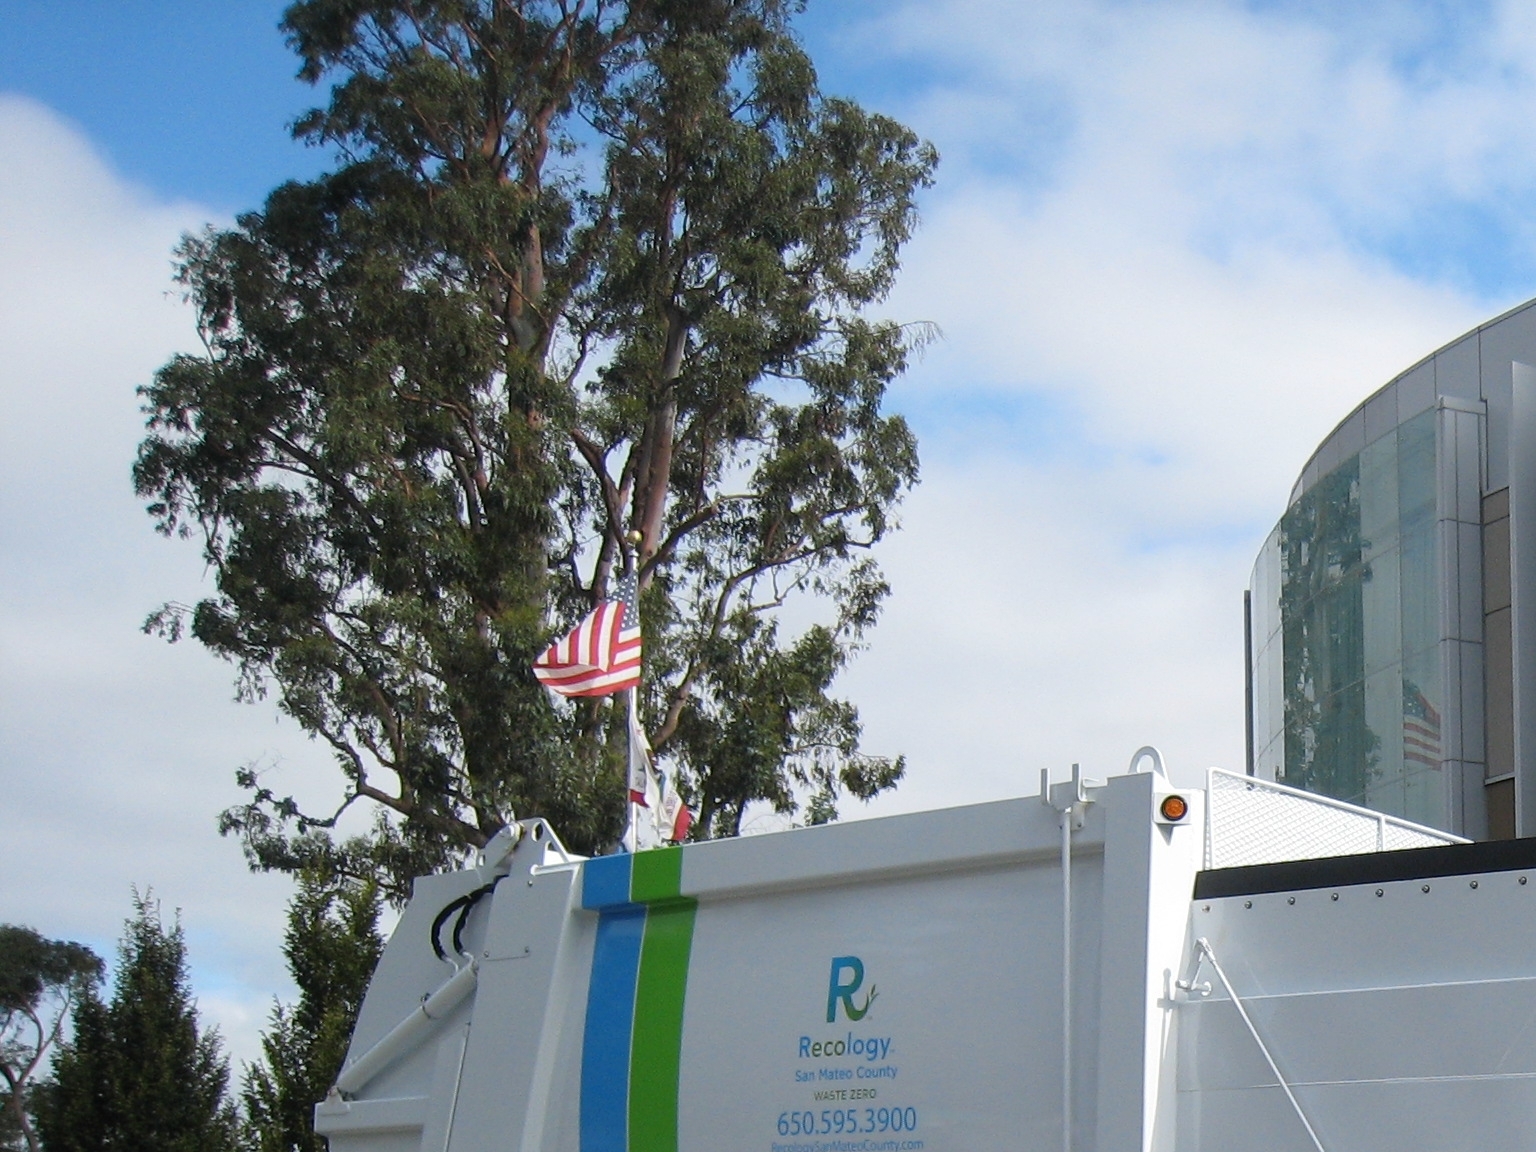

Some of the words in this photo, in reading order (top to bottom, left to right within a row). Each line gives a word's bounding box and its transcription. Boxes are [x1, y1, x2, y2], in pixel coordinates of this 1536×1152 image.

[798, 1032, 892, 1061] Recology
[795, 1070, 815, 1083] San
[818, 1068, 852, 1081] Mateo
[856, 1065, 898, 1080] County
[813, 1089, 847, 1101] WASTE
[850, 1088, 877, 1100] ZERO
[777, 1106, 917, 1137] 650.595.3900
